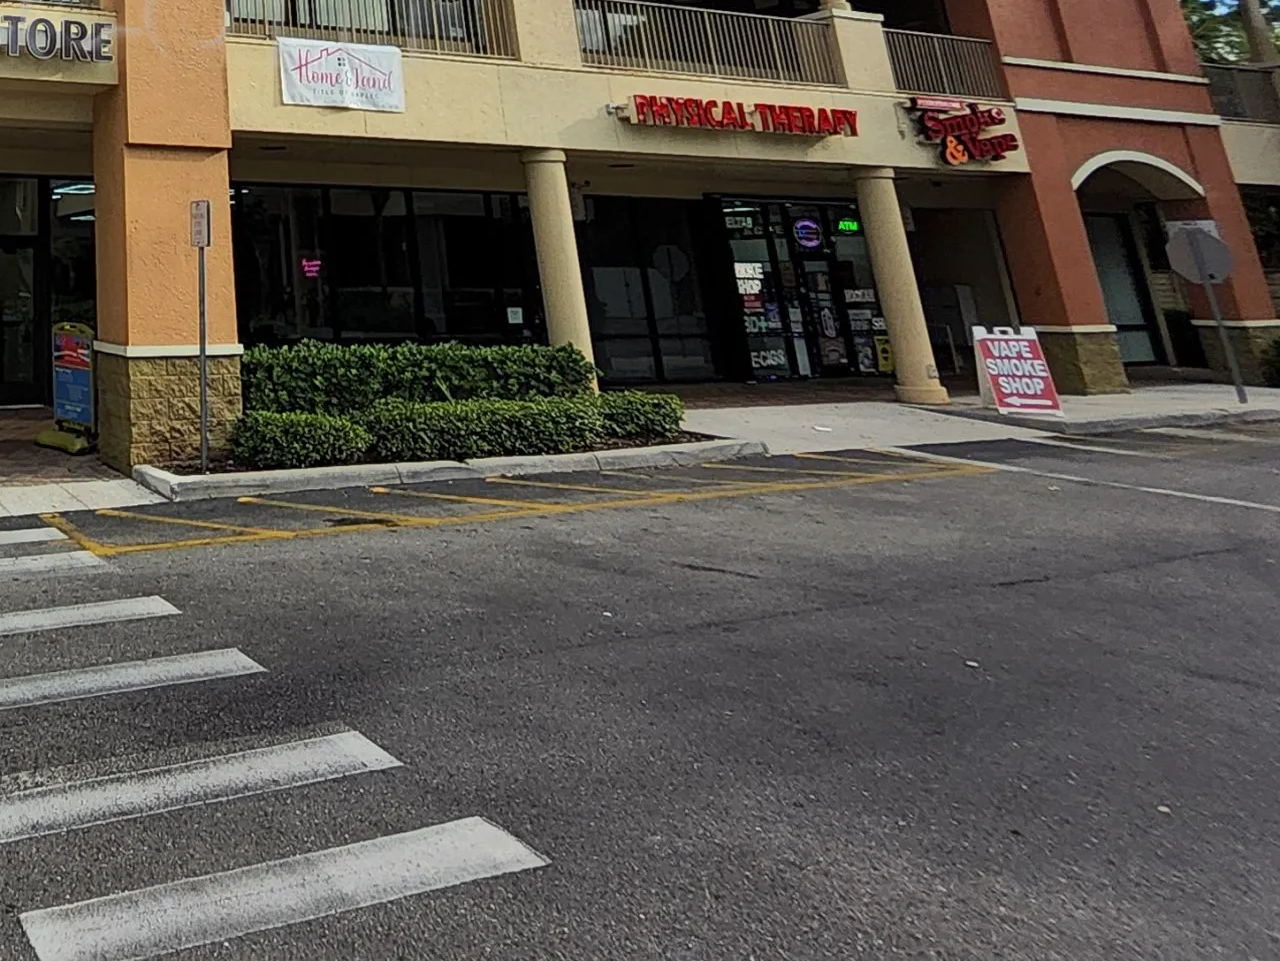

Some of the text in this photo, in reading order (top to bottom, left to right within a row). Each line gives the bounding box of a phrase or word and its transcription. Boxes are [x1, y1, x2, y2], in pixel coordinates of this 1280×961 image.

[291, 48, 344, 87] Home
[353, 67, 395, 93] Land
[632, 94, 859, 137] PHYSICAL THERAPY
[923, 103, 1006, 141] Smoke
[945, 133, 1019, 166] & Vape
[838, 220, 859, 231] ATM
[985, 340, 1034, 359] VAPE
[985, 358, 1049, 378] SMOKE
[997, 376, 1046, 396] SHOP
